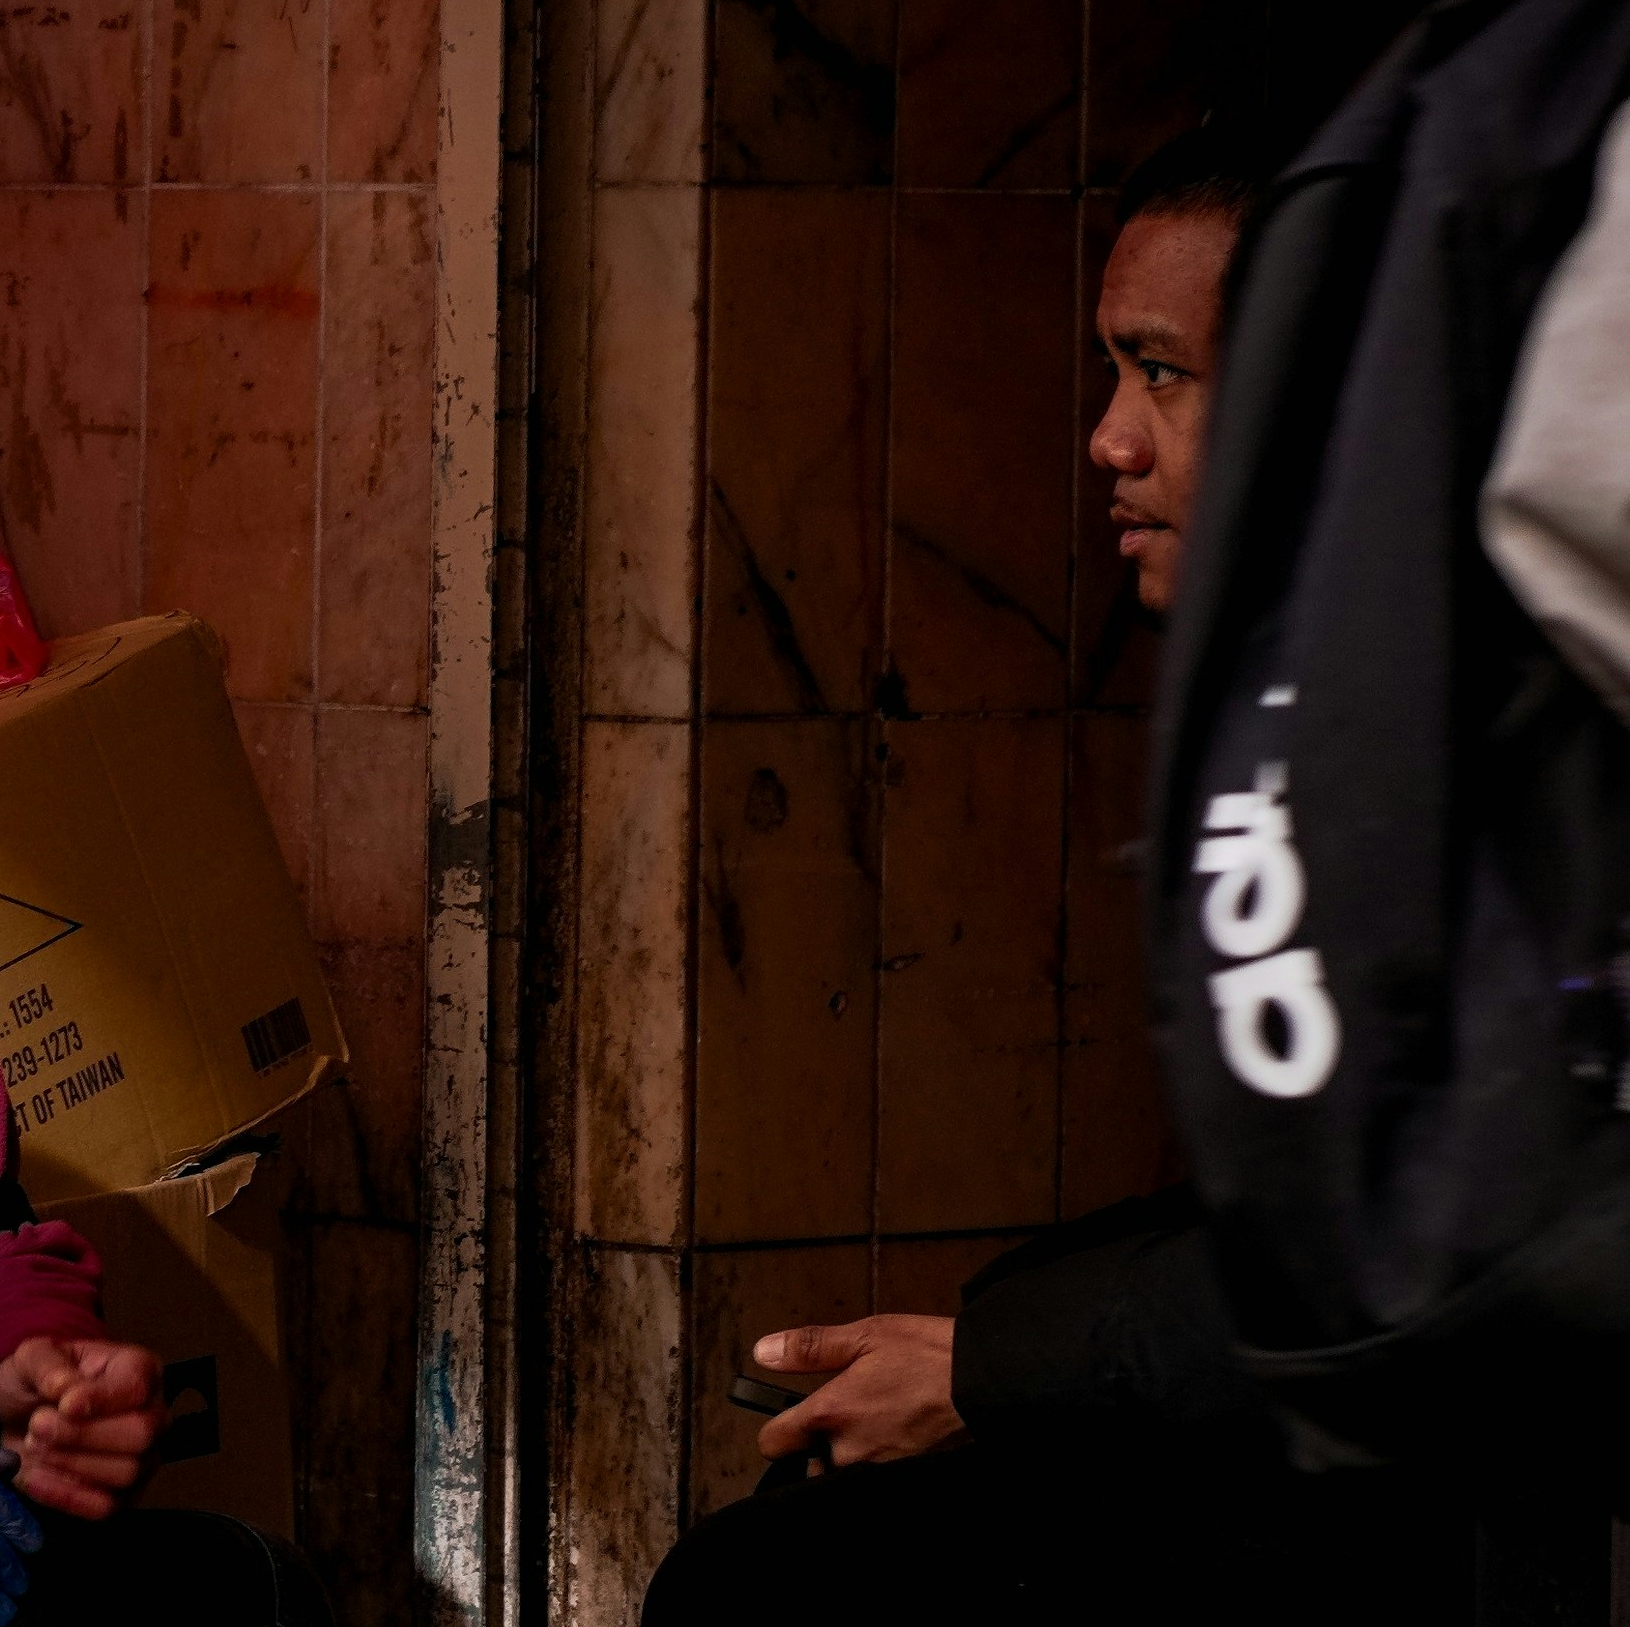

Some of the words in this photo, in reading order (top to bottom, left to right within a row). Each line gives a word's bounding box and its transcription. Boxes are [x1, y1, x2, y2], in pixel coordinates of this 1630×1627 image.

[8, 982, 54, 1024] 1554
[32, 1088, 55, 1125] OF
[56, 1052, 126, 1110] TAIWAN
